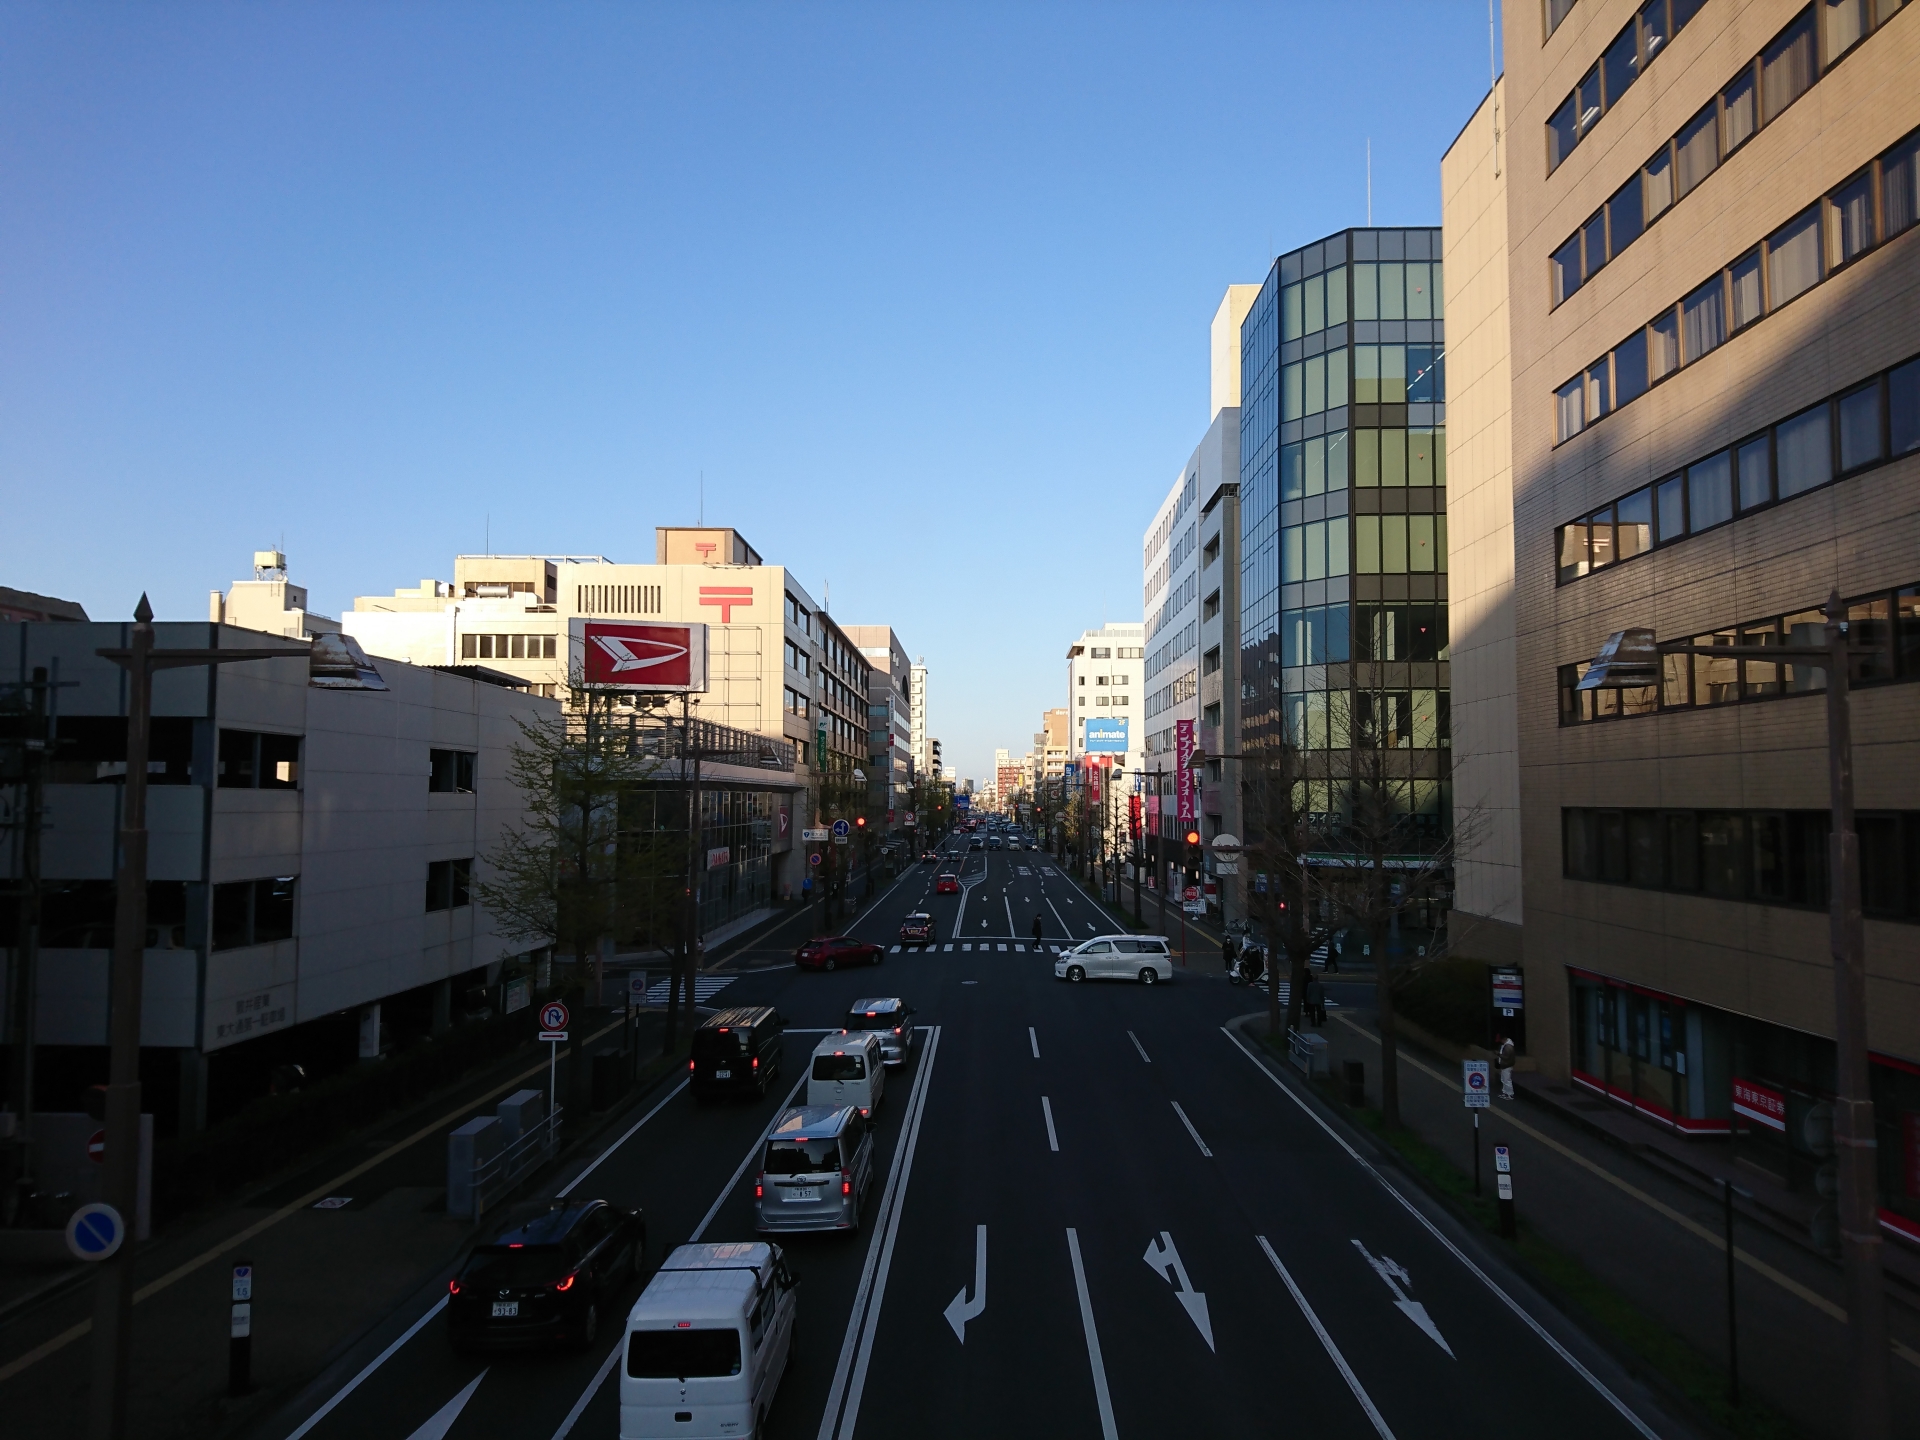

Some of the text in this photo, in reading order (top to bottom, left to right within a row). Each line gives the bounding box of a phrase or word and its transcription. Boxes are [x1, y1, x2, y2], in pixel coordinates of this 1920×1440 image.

[1089, 729, 1125, 739] animate
[1180, 723, 1191, 819] テンプスタフフォーラム
[1735, 1085, 1785, 1115] 東海東京証券
